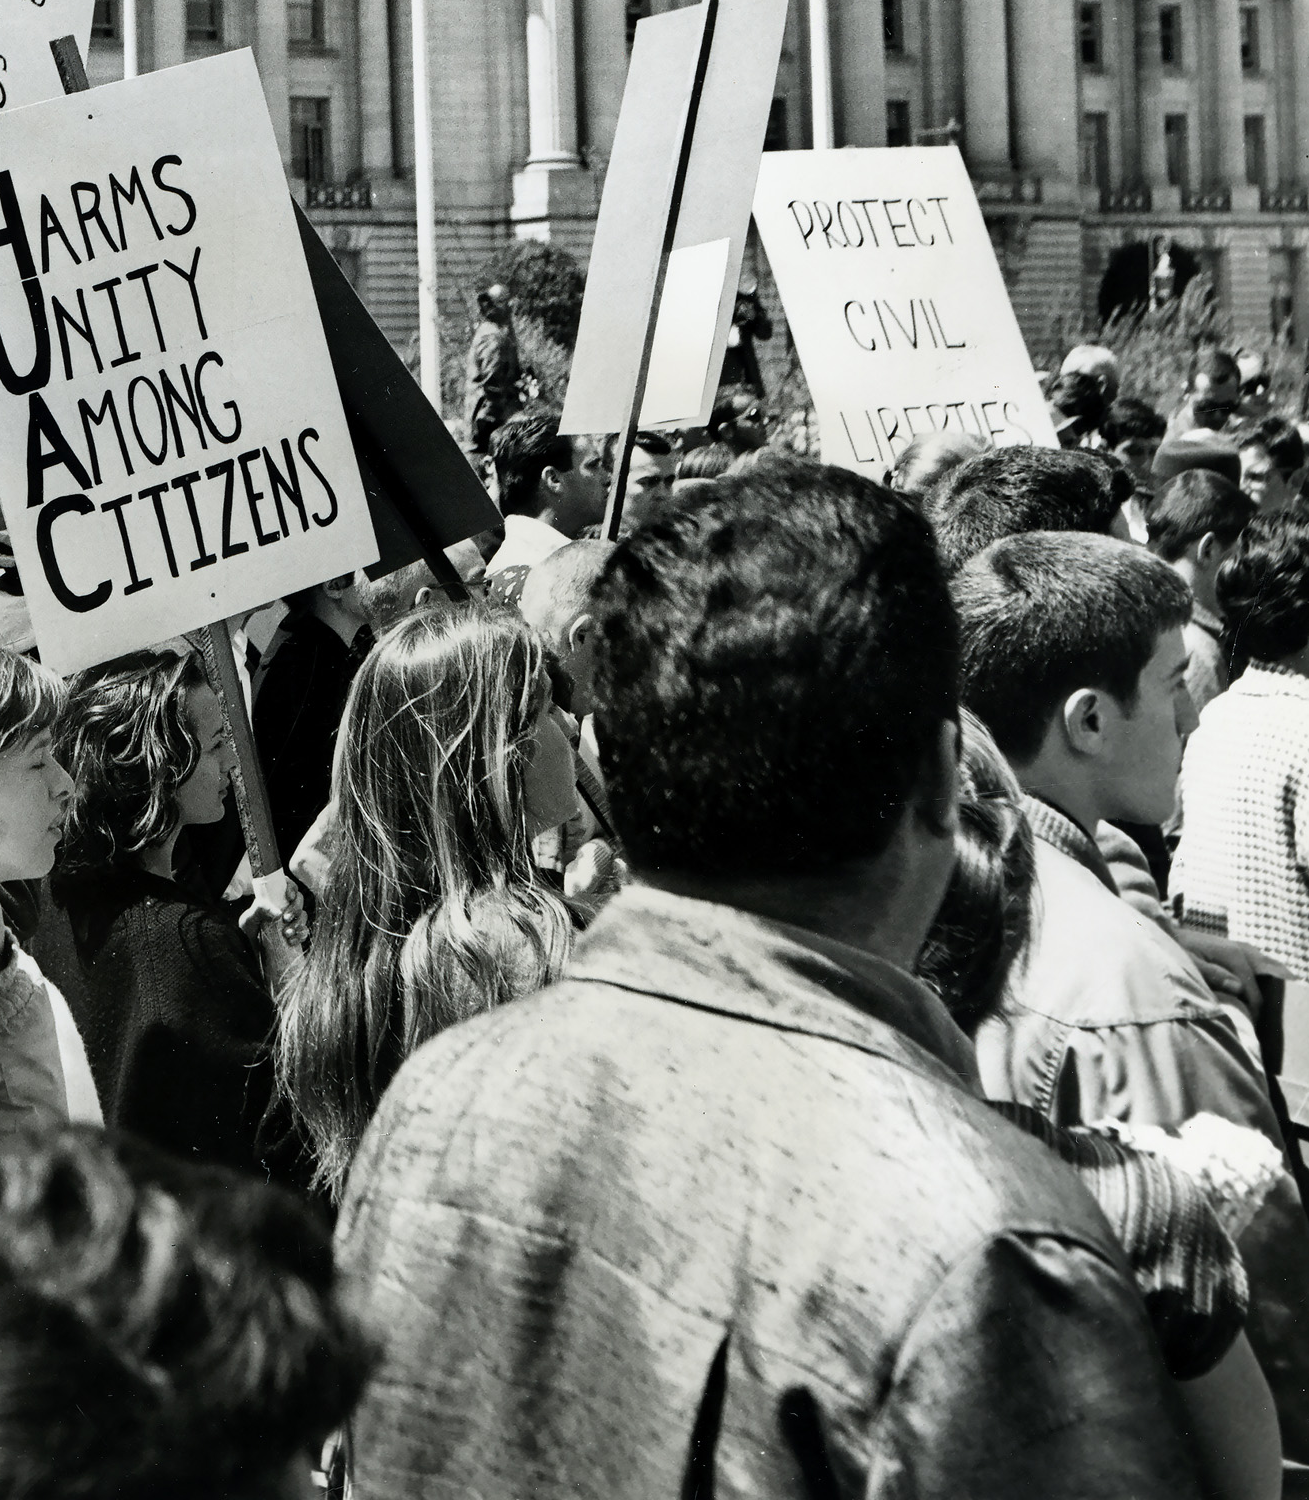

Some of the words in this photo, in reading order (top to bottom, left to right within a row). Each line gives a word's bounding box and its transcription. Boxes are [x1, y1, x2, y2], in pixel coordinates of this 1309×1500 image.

[787, 197, 954, 250] PROTECT
[844, 299, 966, 351] CIVIL
[26, 350, 243, 510] AMONG
[35, 428, 339, 615] CITIZENS
